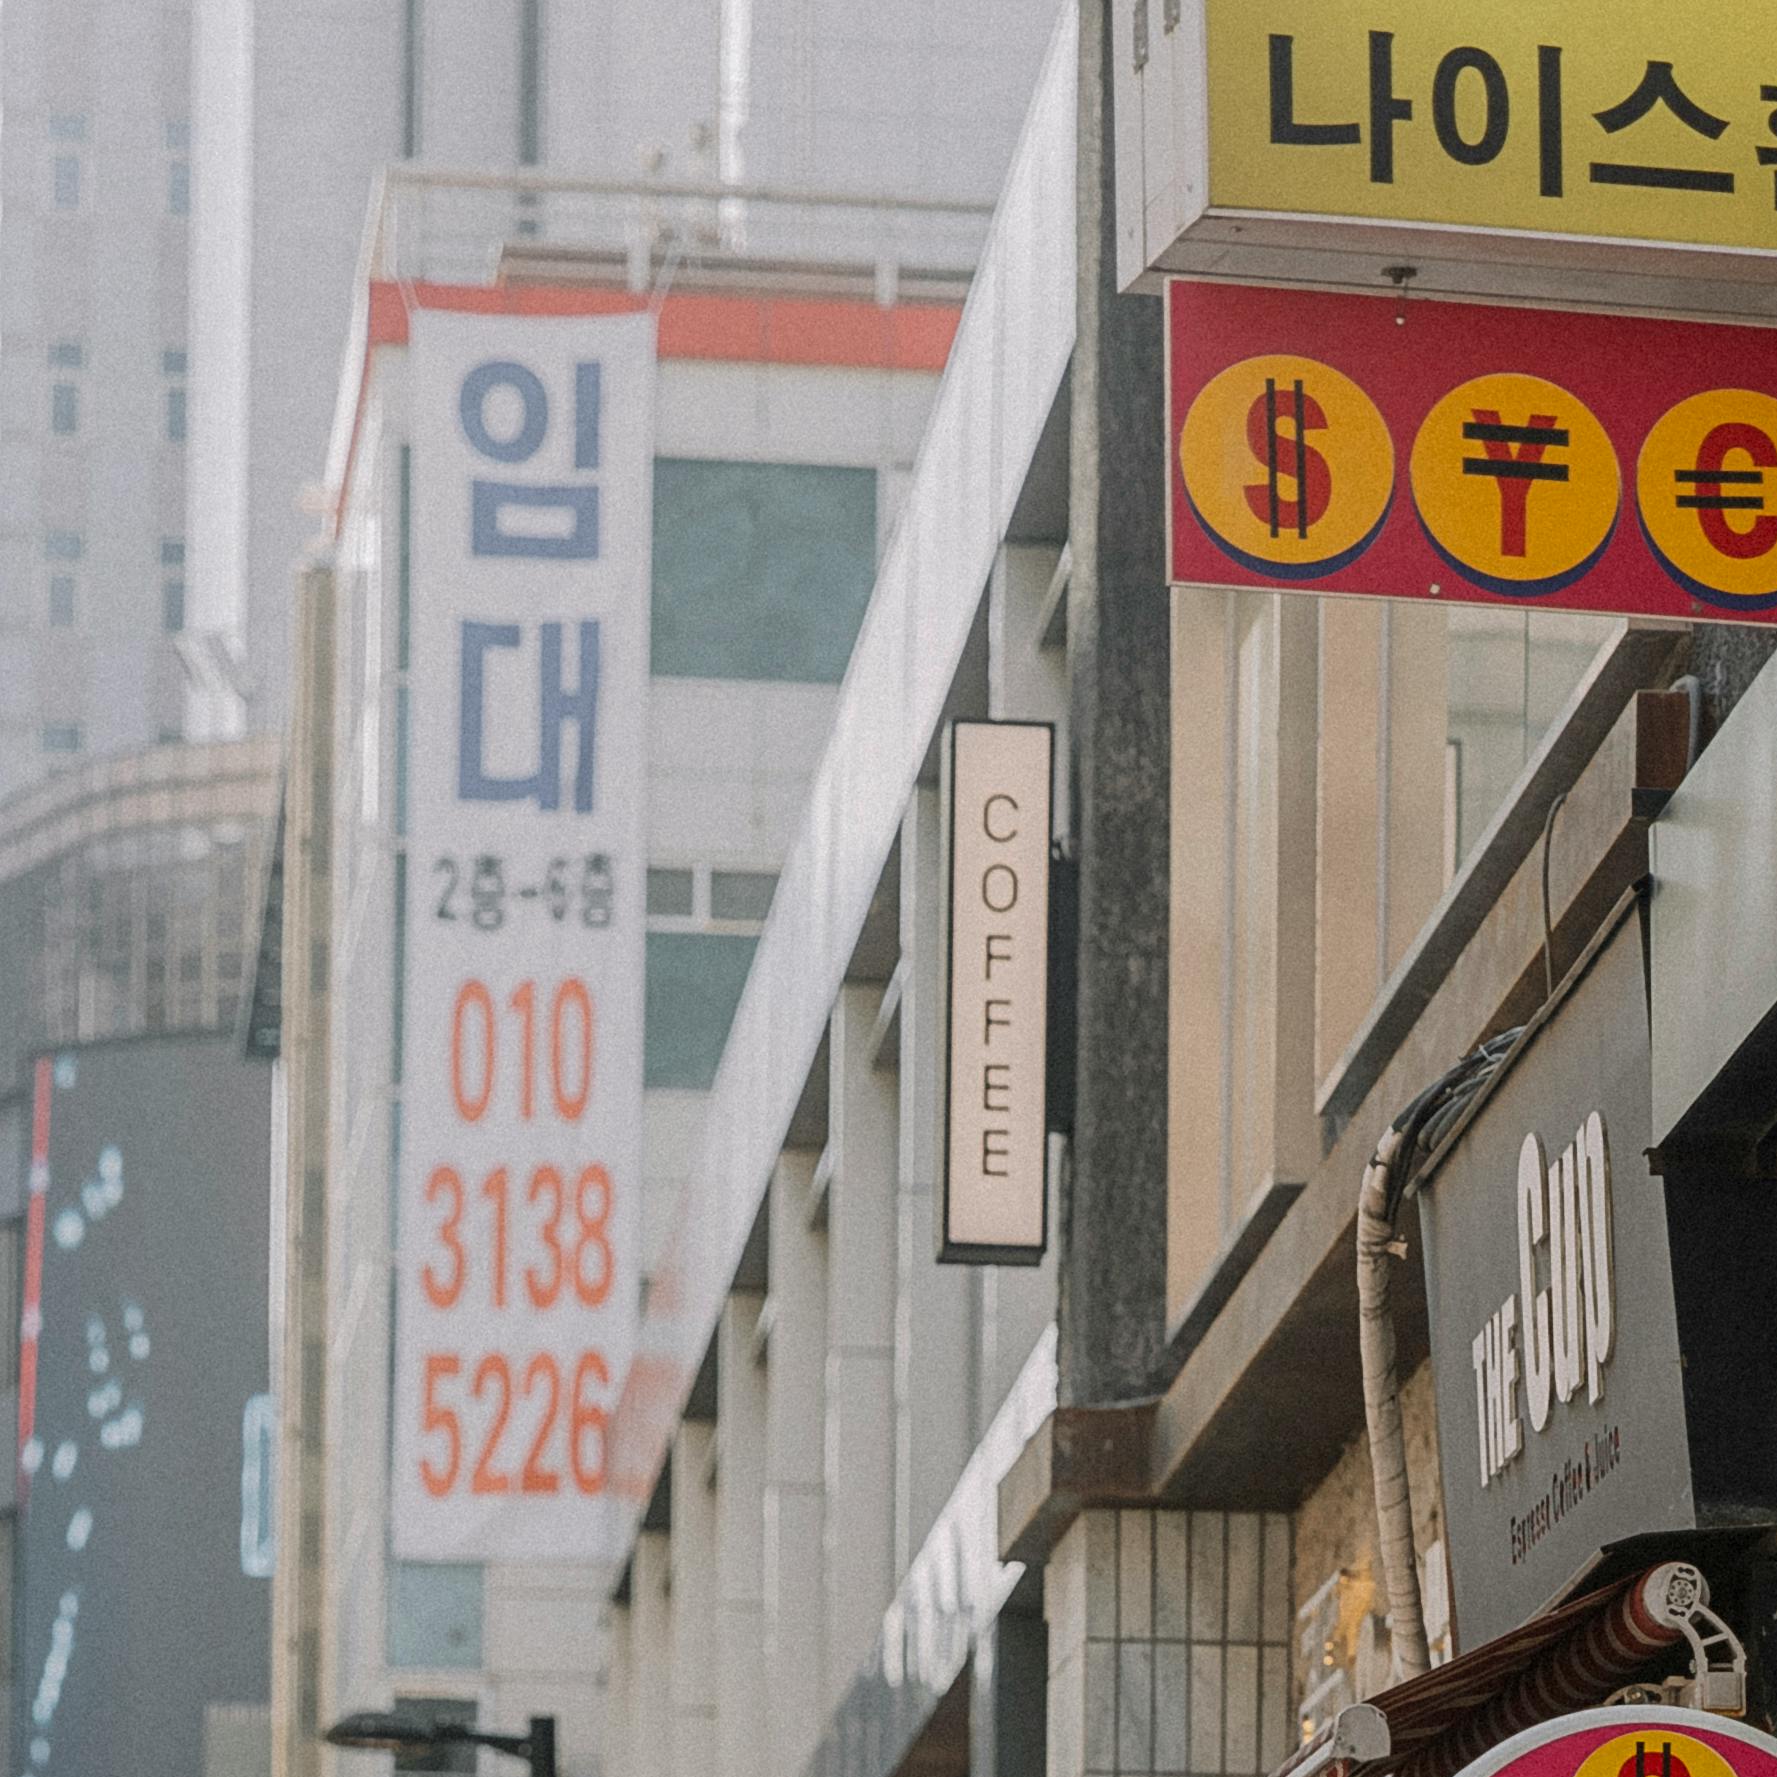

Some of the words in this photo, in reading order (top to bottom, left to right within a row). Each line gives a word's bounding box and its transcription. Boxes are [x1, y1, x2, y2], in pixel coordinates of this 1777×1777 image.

[458, 360, 603, 815] 임대
[449, 976, 597, 1125] 010
[982, 793, 1020, 1178] COFFEE
[418, 1164, 616, 1310] 3138
[416, 1351, 614, 1500] 5226
[1471, 1293, 1522, 1489] THE
